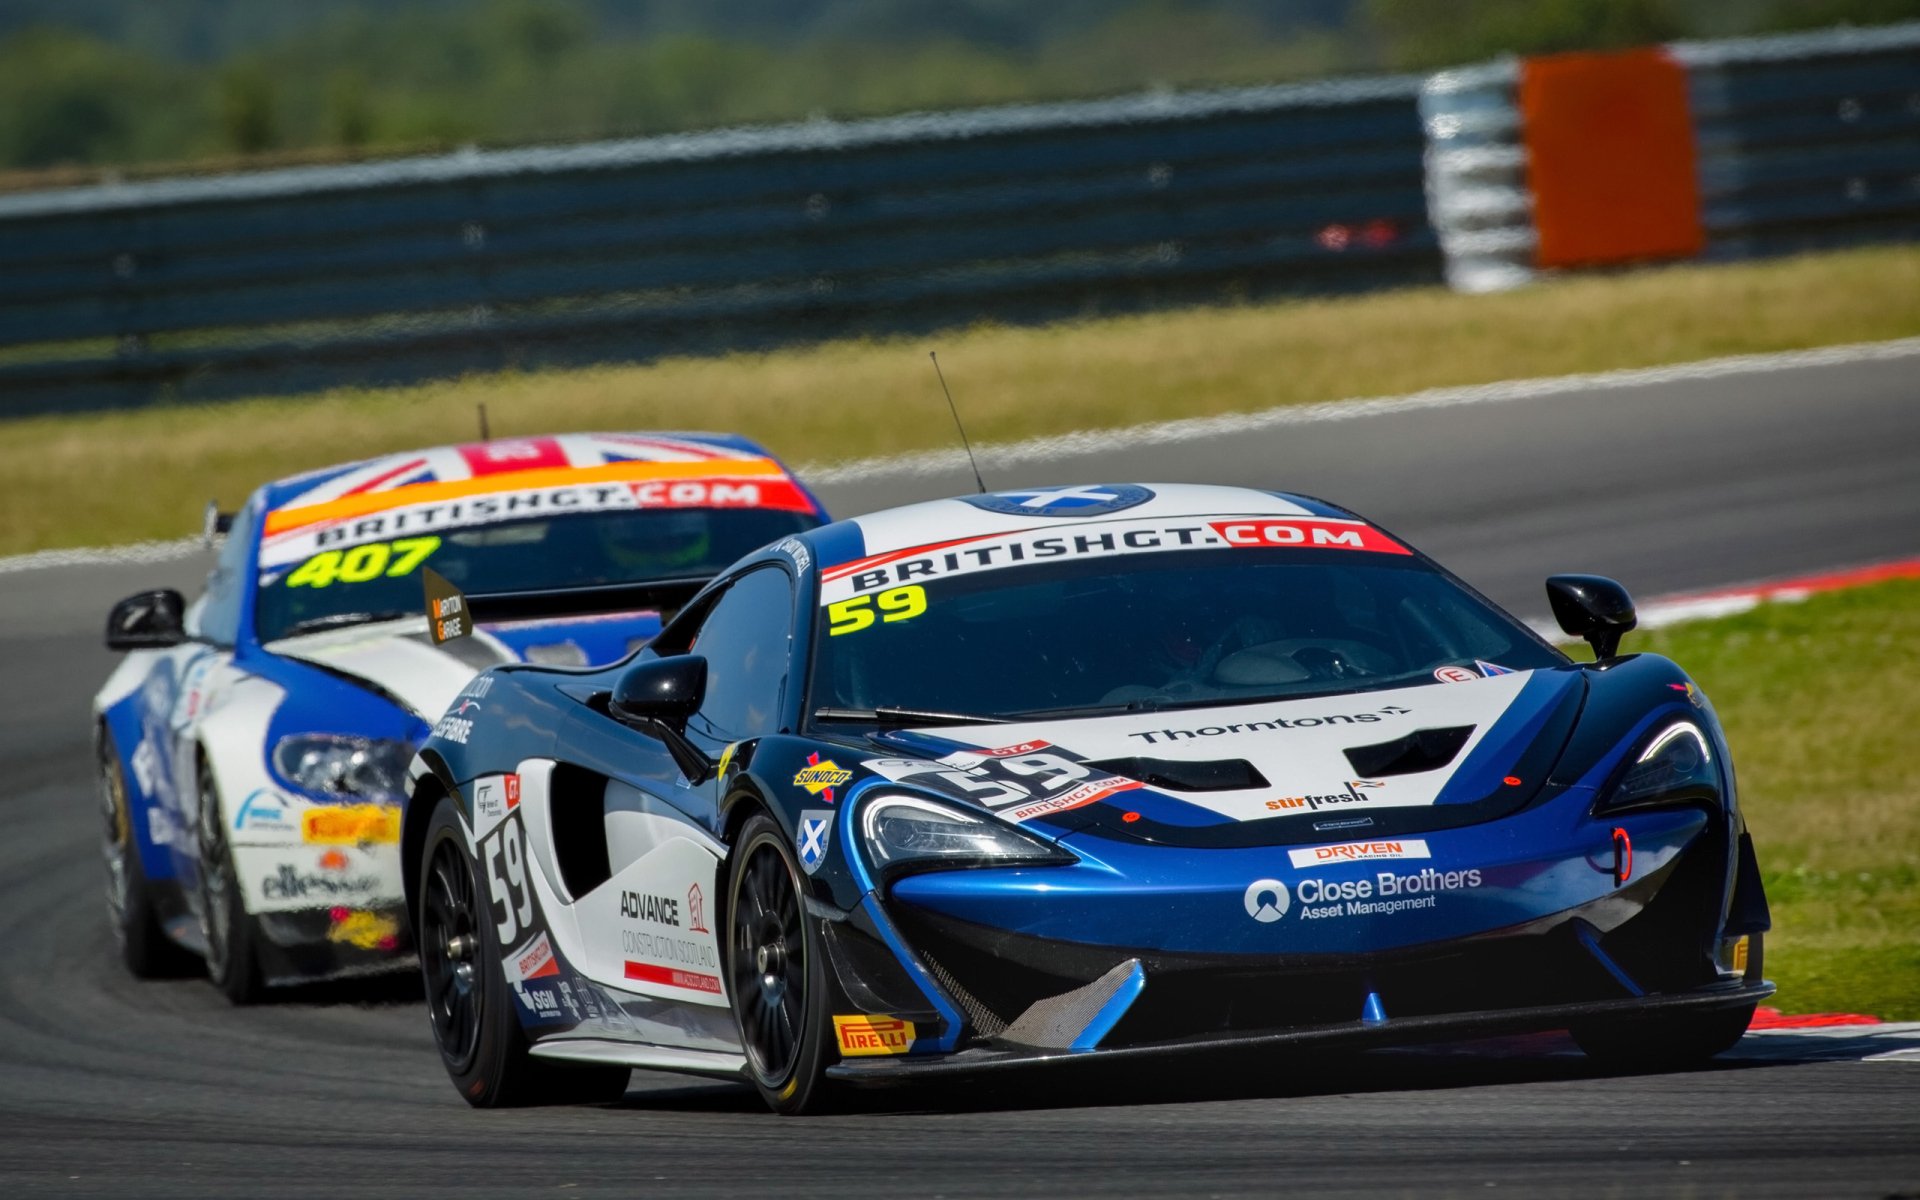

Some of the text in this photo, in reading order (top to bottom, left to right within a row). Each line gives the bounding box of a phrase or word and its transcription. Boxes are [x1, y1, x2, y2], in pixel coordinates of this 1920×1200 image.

[316, 483, 759, 547] BRITISHGT.COM
[286, 536, 442, 588] 407
[852, 525, 1364, 592] BRITISHGT.COM
[828, 585, 928, 637] 59
[1128, 711, 1384, 745] Thorntons
[992, 743, 1034, 757] GT4
[796, 769, 851, 786] SUNOCO
[937, 753, 1091, 808] 59
[1015, 775, 1133, 820] BRITISHGT.COM
[1265, 781, 1369, 811] stirfresh
[1315, 842, 1404, 860] DRIVEN
[484, 817, 533, 945] 59
[1297, 868, 1482, 904] Close Brothers
[620, 890, 680, 927] ADVANCE
[1300, 895, 1436, 921] Asset Management
[532, 989, 559, 1010] SGM
[840, 1020, 908, 1049] PIRELLI
